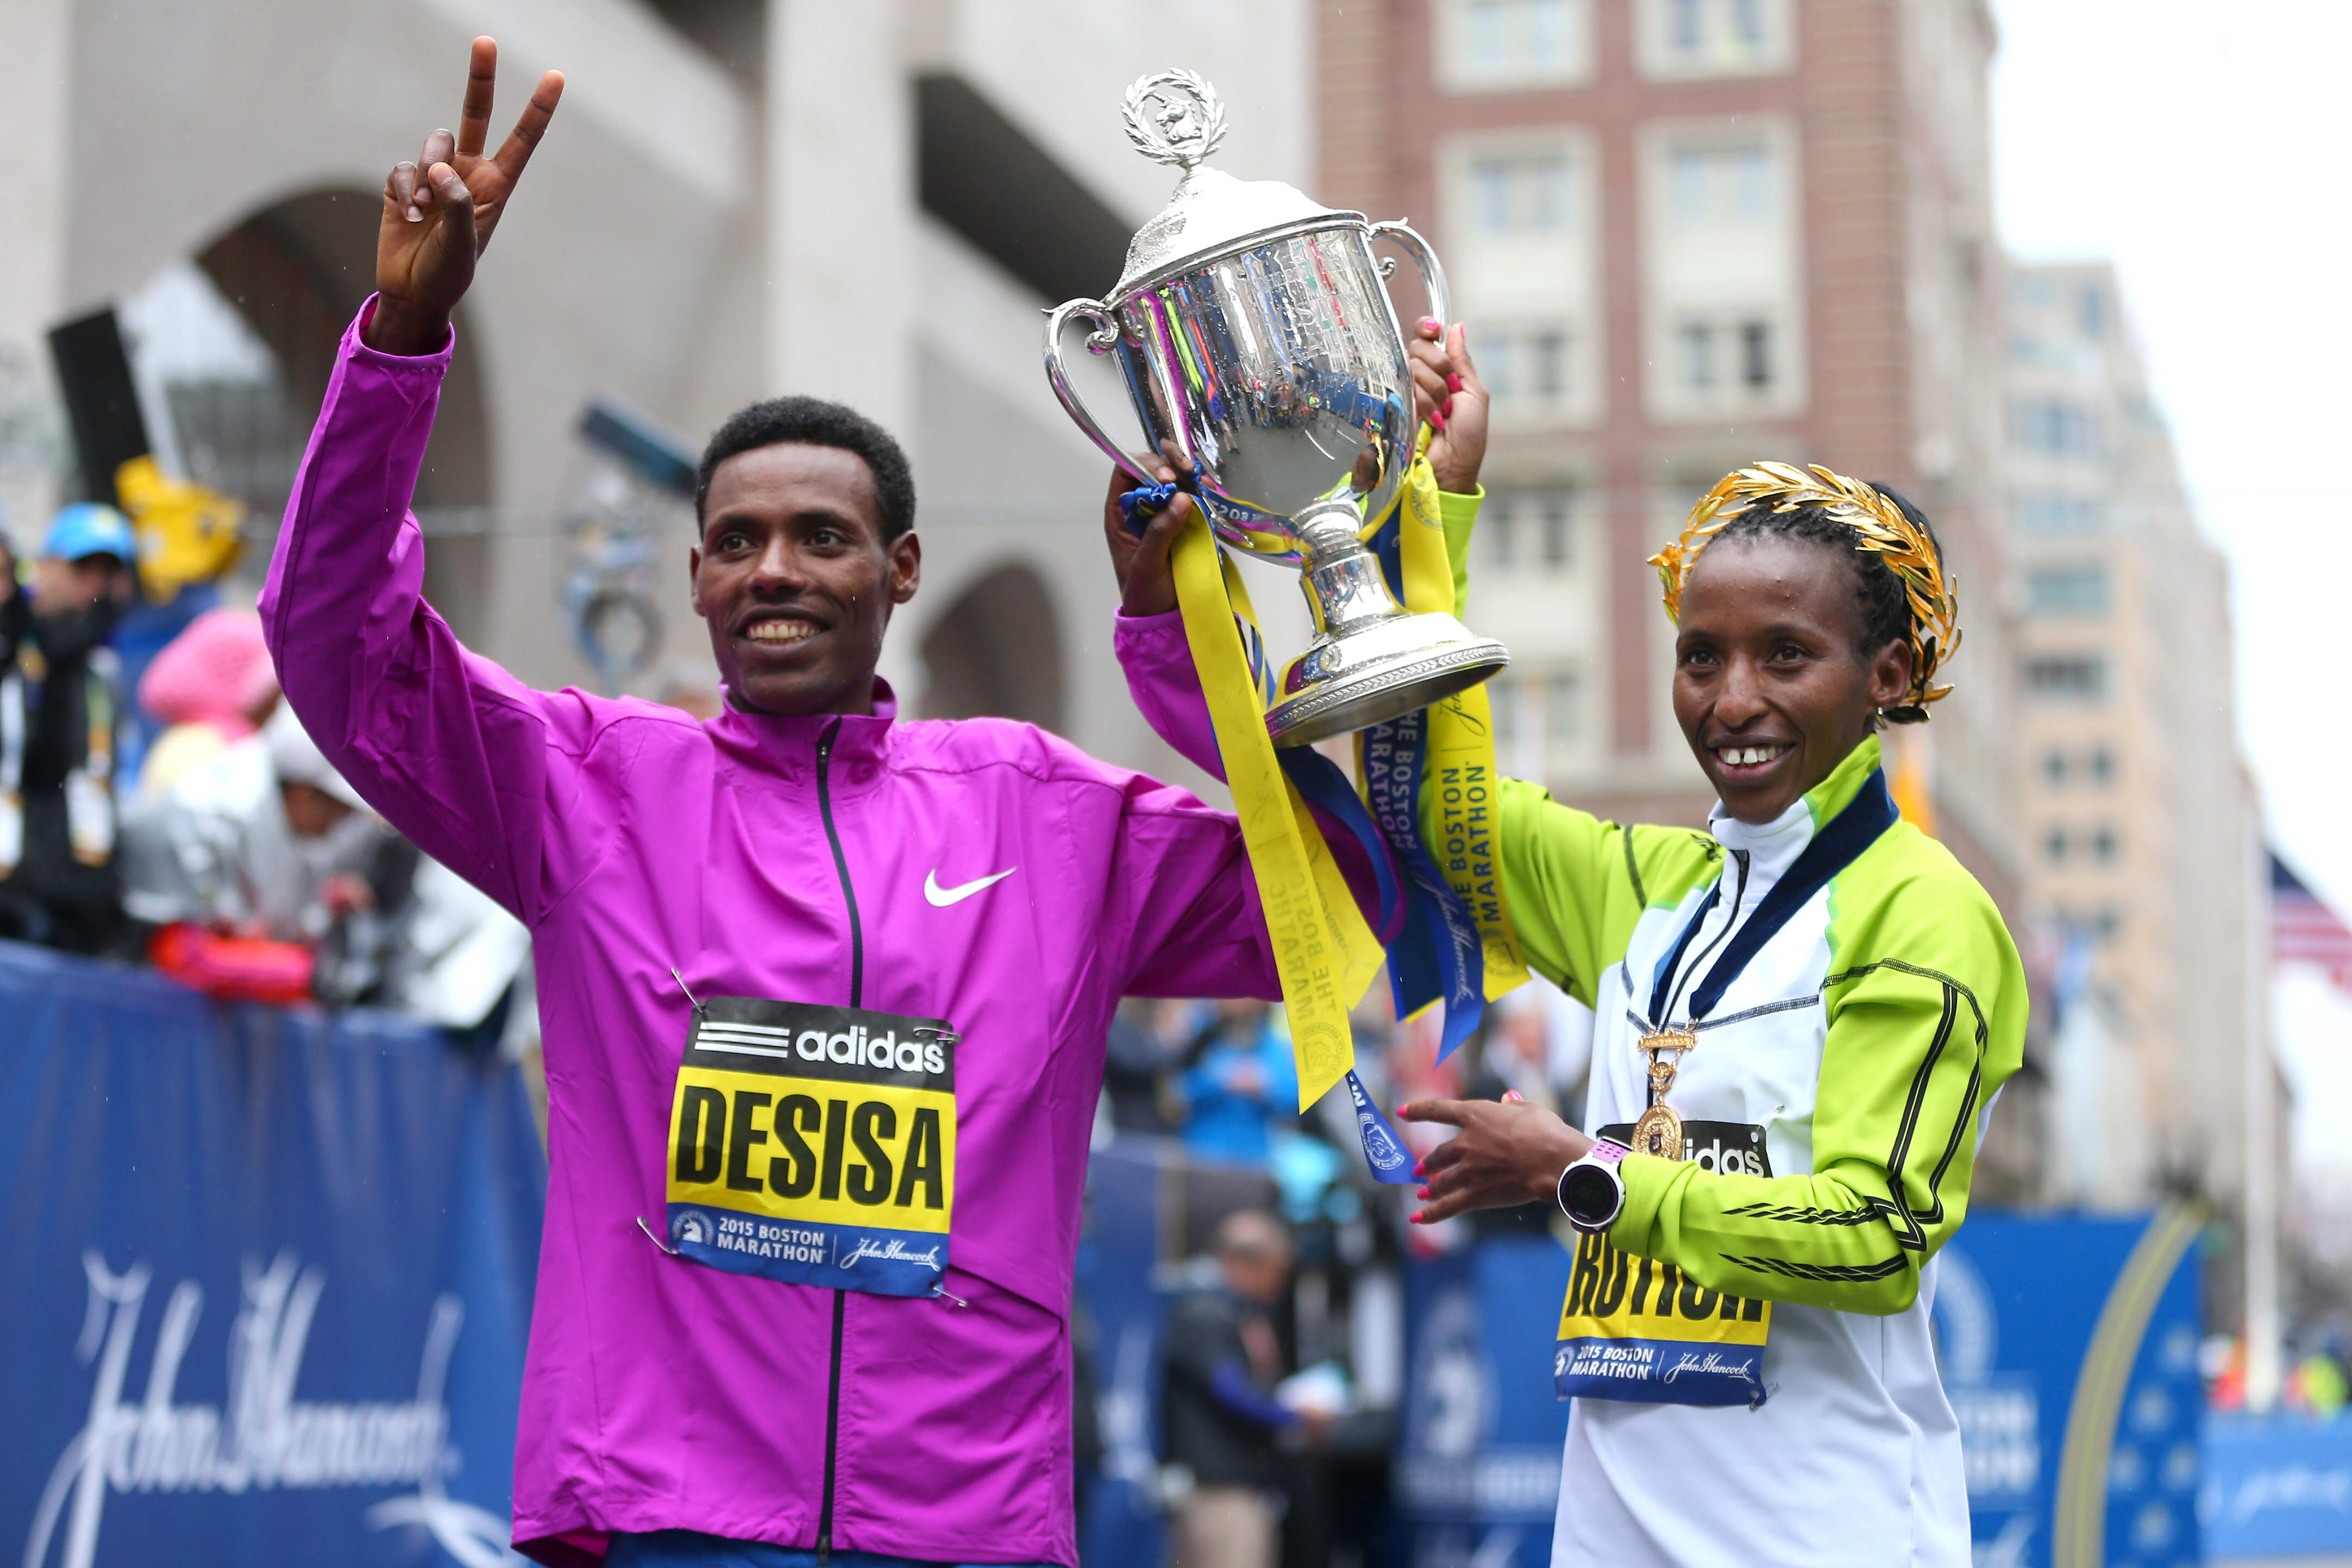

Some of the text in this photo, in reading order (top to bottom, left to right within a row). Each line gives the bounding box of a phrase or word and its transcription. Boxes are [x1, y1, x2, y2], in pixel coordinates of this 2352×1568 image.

[1370, 724, 1405, 850] ARATHON
[1391, 711, 1419, 850] HE BOSTON
[1441, 768, 1467, 872] BOSTON
[1466, 766, 1502, 923] MARATHON
[795, 1025, 945, 1075] adidas
[675, 1084, 944, 1211] DESISA
[1681, 1138, 1764, 1178] idas
[717, 1232, 823, 1264] MARATHON
[719, 1216, 754, 1236] 2015
[757, 1225, 825, 1246] BOSTON
[840, 1238, 943, 1272] John Hancock
[1569, 1361, 1650, 1381] MARATHON
[1576, 1345, 1653, 1363] 2015 BOSTON
[1664, 1352, 1755, 1384] John Hancock
